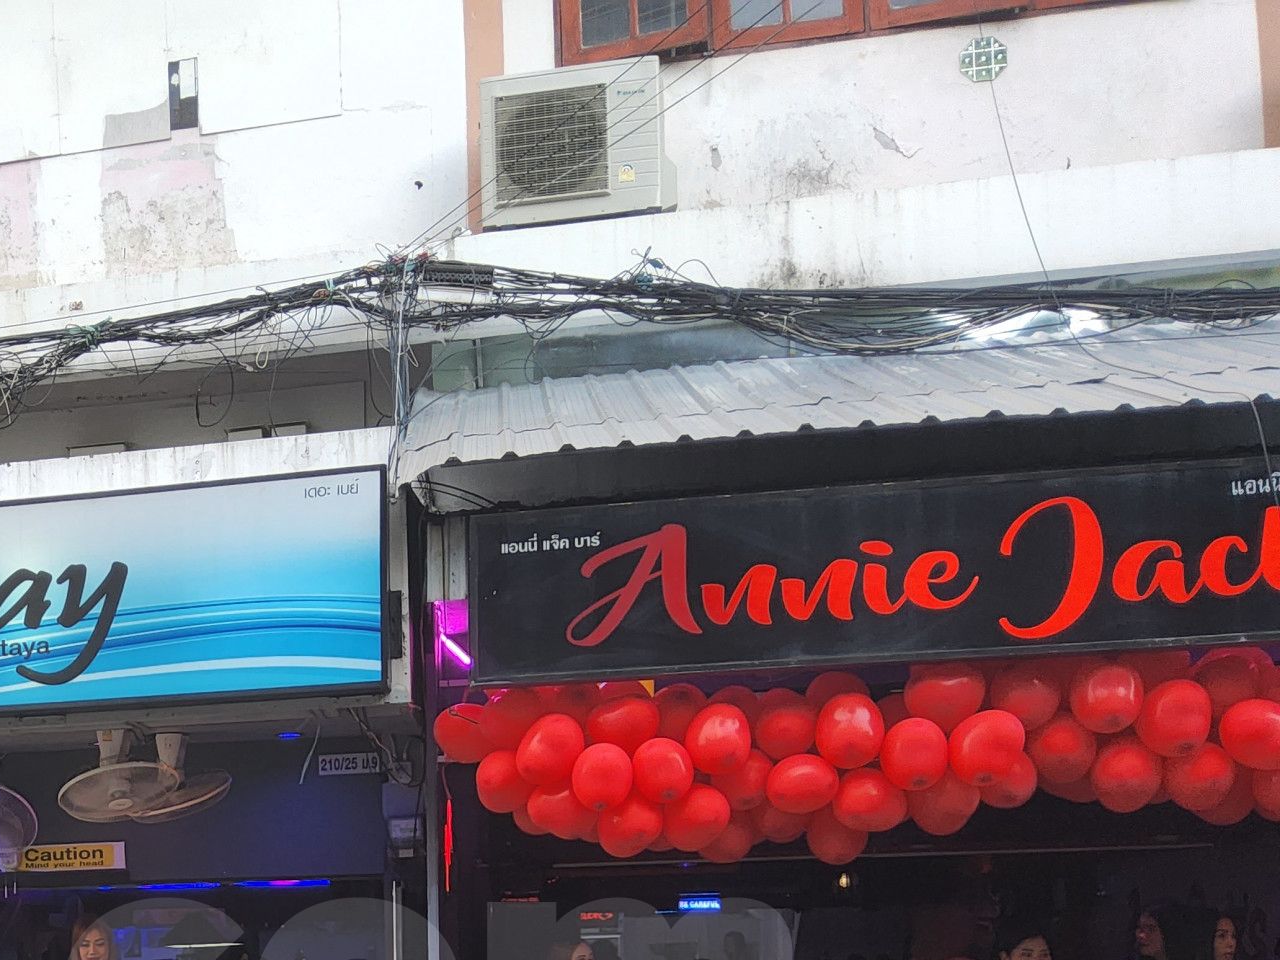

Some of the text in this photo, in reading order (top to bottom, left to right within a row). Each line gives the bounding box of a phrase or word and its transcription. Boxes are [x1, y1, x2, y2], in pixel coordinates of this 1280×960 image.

[501, 531, 601, 554] แอนนี่ แจ็ค บาร์
[566, 522, 979, 647] Annie
[320, 757, 358, 771] 210/25
[24, 848, 104, 862] Caution
[25, 859, 104, 869] Mind your head
